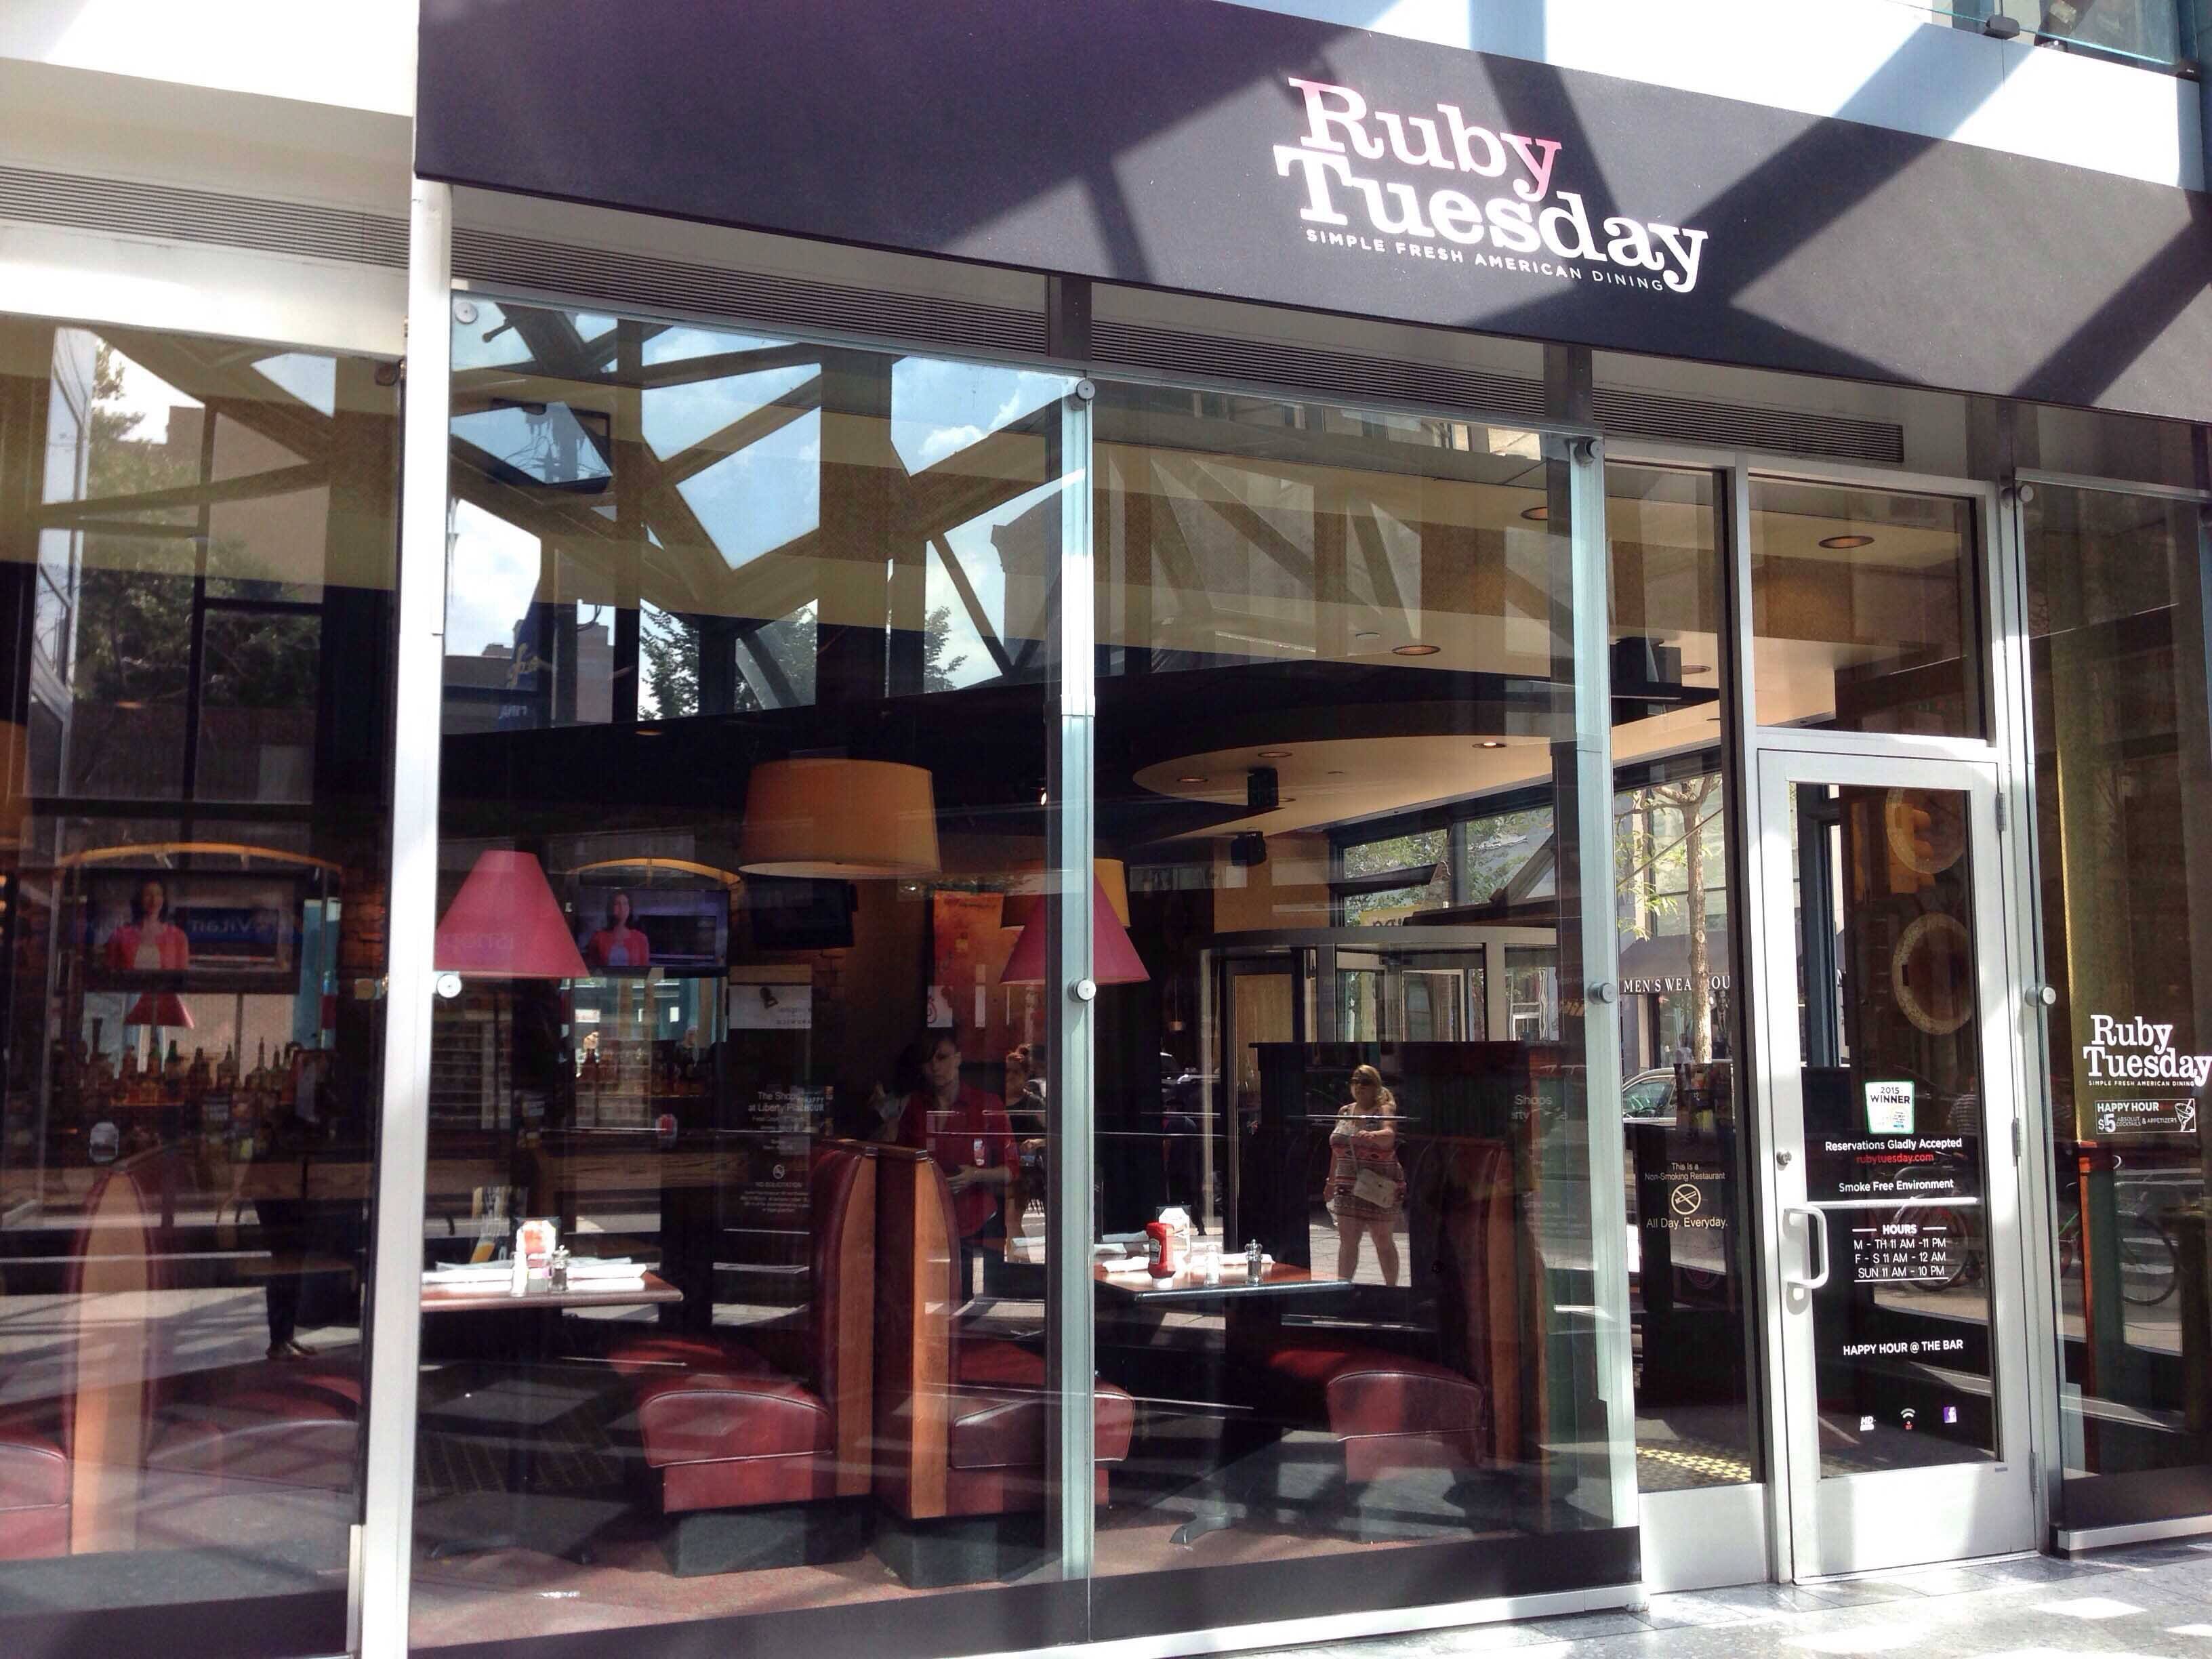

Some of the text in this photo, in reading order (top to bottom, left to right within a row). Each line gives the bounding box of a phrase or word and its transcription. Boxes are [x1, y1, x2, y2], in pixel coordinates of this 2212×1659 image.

[1288, 77, 1562, 201] Ruby
[1273, 145, 1708, 293] Tuesday
[1307, 229, 1662, 291] SIMPLE FRESH AMERICAN DINING
[1624, 979, 1661, 993] MEN'S
[2090, 1015, 2173, 1054] Ruby
[2083, 1046, 2212, 1087] Tuesday
[1870, 1094, 1910, 1104] WINNER
[2097, 1101, 2159, 1112] HAPPY HOUR
[2098, 1113, 2116, 1132] $5
[1825, 1137, 1962, 1151] Reservations Gladly Accepted
[1856, 1153, 1934, 1164] rubytuesday.com
[1671, 1162, 1685, 1170] This
[1645, 1172, 1725, 1181] Non-Smoking Restaurant
[1839, 1179, 1954, 1193] Smoke Free Environment
[1646, 1218, 1658, 1228] All
[1683, 1217, 1728, 1229] Everyday.
[1883, 1224, 1917, 1235] HOURS
[1853, 1240, 1863, 1250] M
[1875, 1239, 1887, 1250] TH
[1890, 1239, 1896, 1248] 11
[1900, 1238, 1914, 1248] AM
[1932, 1237, 1946, 1248] PM
[1856, 1254, 1861, 1264] F
[1873, 1253, 1880, 1263] S
[1883, 1253, 1889, 1263] 11
[1893, 1252, 1908, 1263] AM
[1919, 1252, 1928, 1262] 12
[1931, 1252, 1946, 1262] AM
[1858, 1267, 1879, 1278] SUN
[1882, 1267, 1888, 1277] 11
[1891, 1267, 1906, 1277] AM
[1919, 1266, 1927, 1276] 10
[1931, 1265, 1944, 1275] PM
[1843, 1339, 1963, 1355] HAPPY HOUR @ THE BAR
